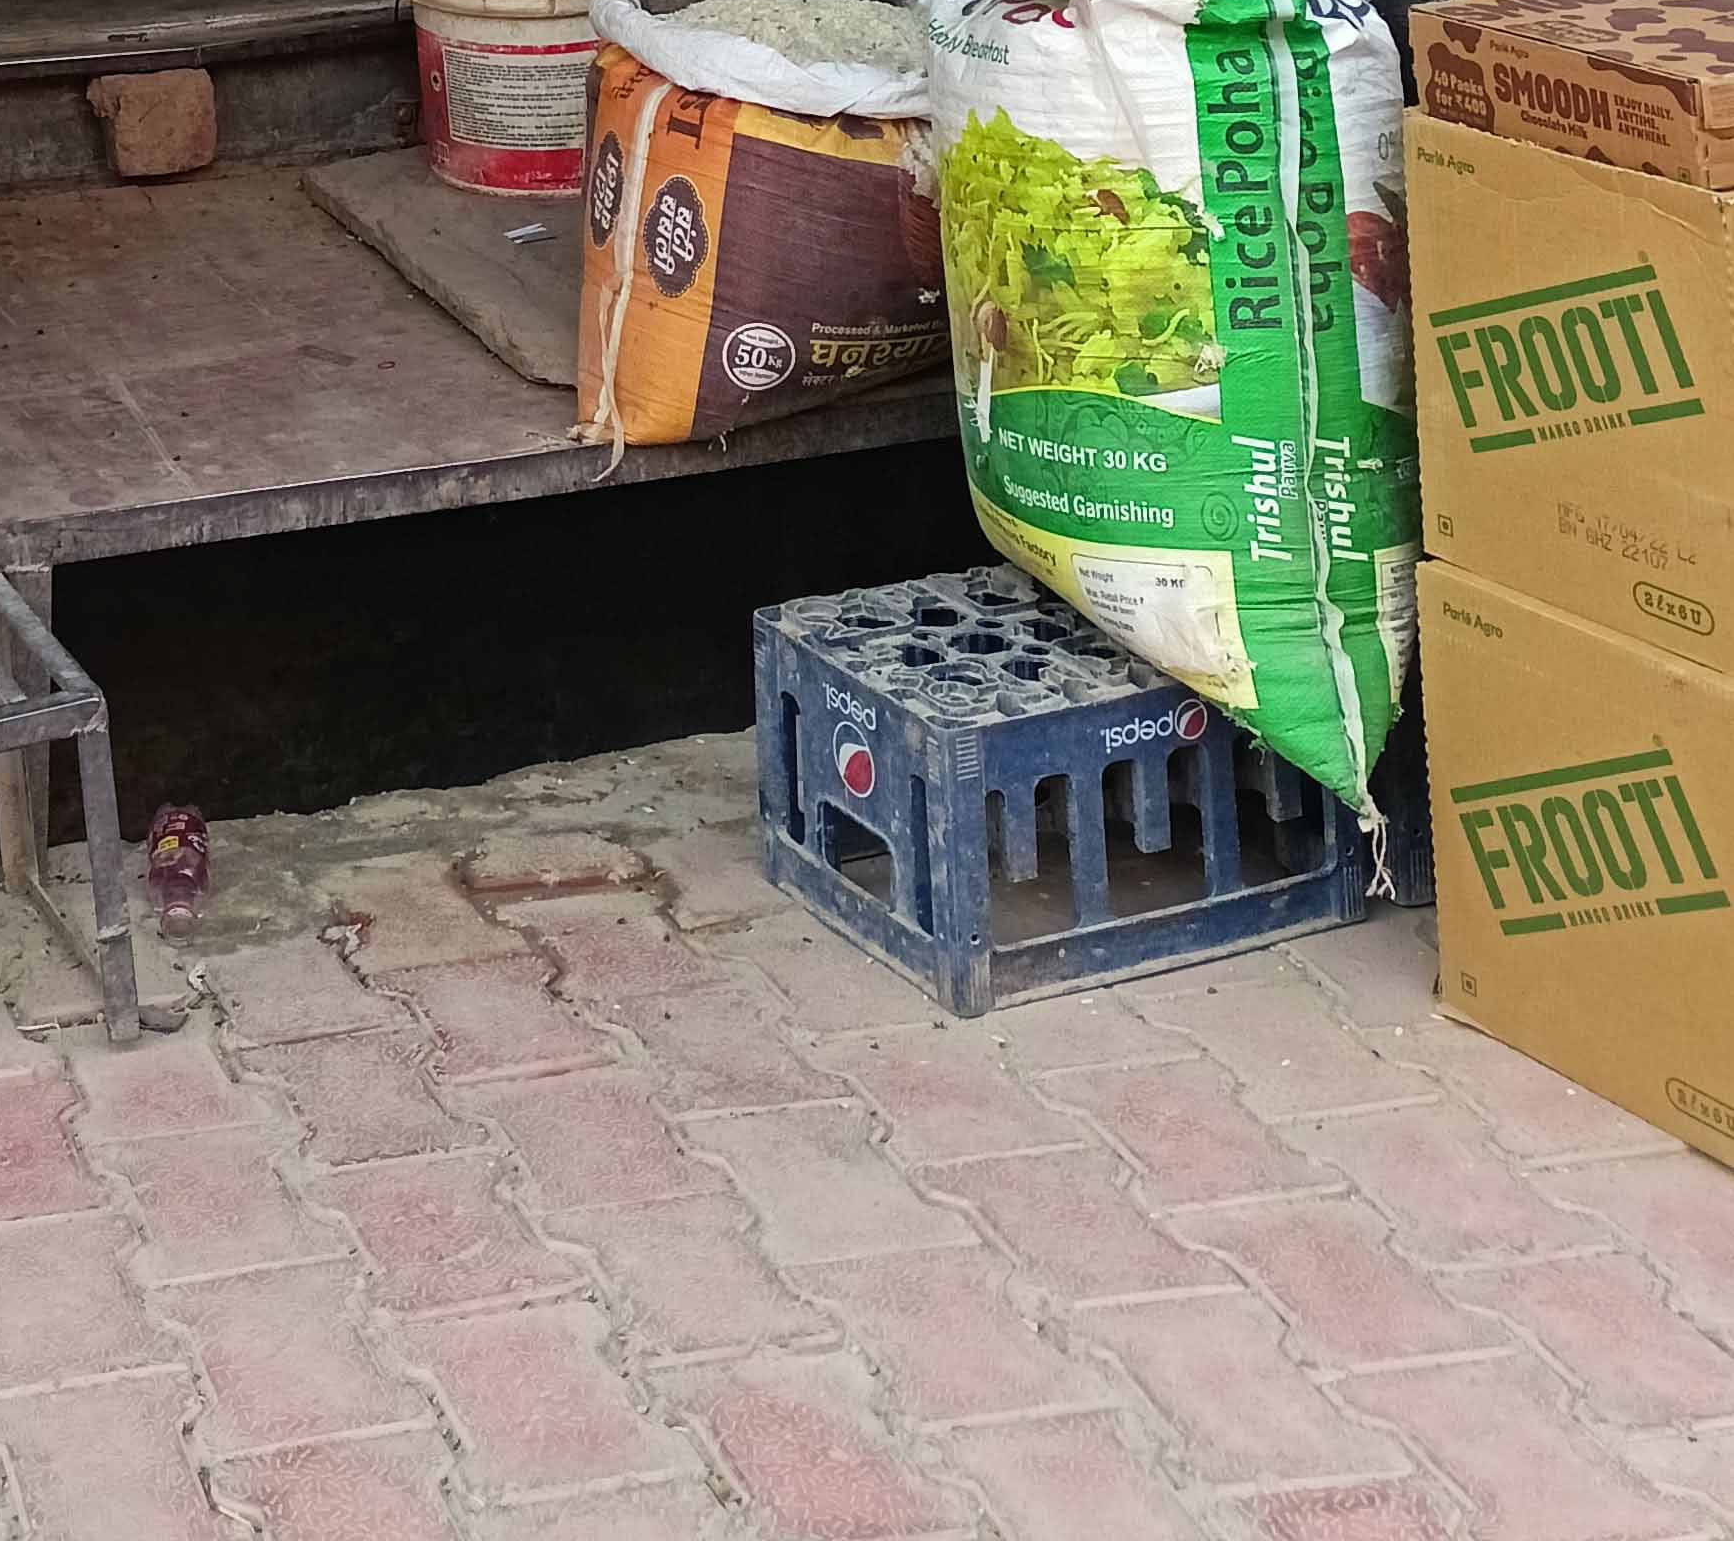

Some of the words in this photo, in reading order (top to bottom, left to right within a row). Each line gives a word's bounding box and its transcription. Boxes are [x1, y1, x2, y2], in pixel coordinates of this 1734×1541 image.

[1435, 70, 1448, 88] 40
[1451, 74, 1484, 97] Packs
[1435, 89, 1453, 105] for
[1494, 62, 1613, 131] SMOODH
[1614, 94, 1643, 111] ENJOY
[1521, 110, 1566, 134] Chocolate
[1568, 123, 1589, 140] Milk
[1448, 154, 1475, 175] Agro
[812, 323, 871, 335] Processed
[1437, 289, 1695, 429] FROOTI
[1538, 420, 1581, 442] MANGO
[1586, 413, 1626, 434] DRINK
[999, 428, 1024, 452] NET
[1028, 437, 1097, 467] WEIGHT
[1104, 451, 1127, 469] 30
[1134, 453, 1167, 472] KG
[1004, 476, 1069, 514] Suggested
[1074, 496, 1175, 528] Garnishing
[1231, 435, 1292, 561] Trishul
[1315, 437, 1369, 561] Trishul
[1475, 614, 1504, 640] Agro
[1460, 775, 1719, 910] FROOTI
[1568, 906, 1611, 927] MANGO
[1613, 901, 1655, 921] DRINK
